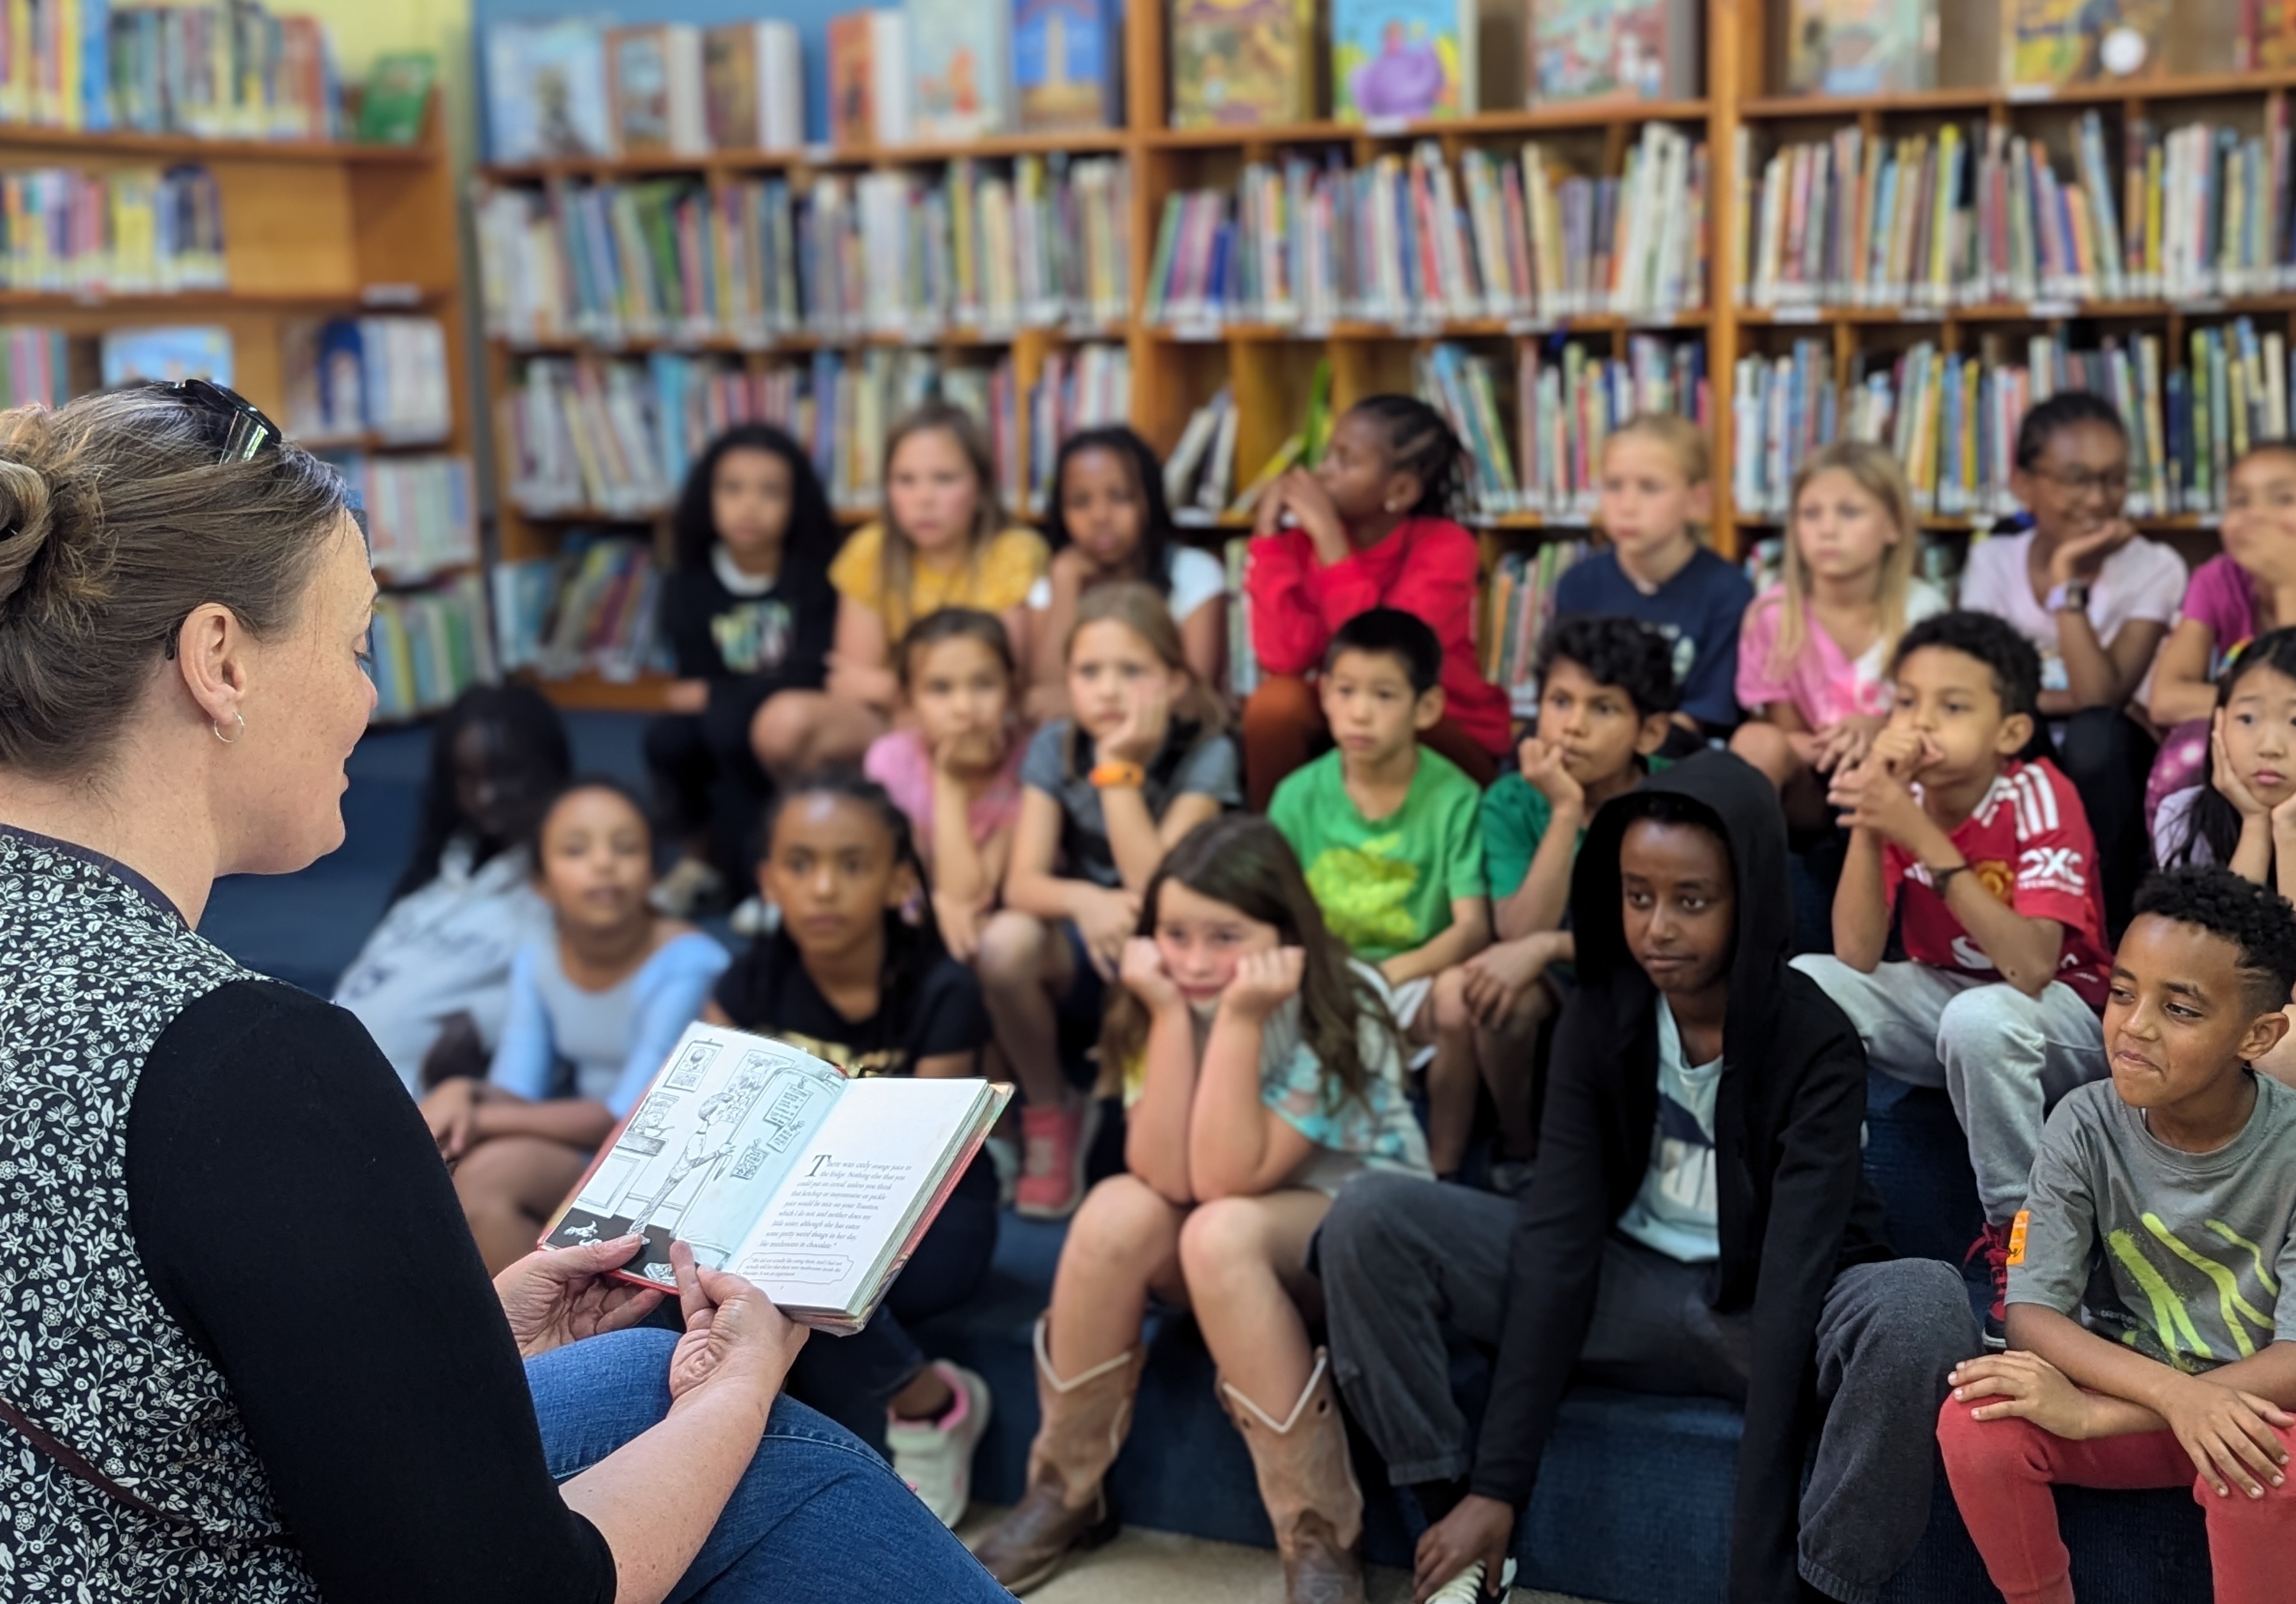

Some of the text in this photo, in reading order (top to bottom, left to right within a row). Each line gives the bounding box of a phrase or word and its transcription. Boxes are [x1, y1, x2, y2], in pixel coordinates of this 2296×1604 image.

[2018, 846, 2086, 886] DXC
[856, 1160, 872, 1171] only
[846, 1172, 870, 1180] Nothing
[802, 1190, 822, 1199] ketchup
[868, 1193, 887, 1201] pickle
[800, 1219, 824, 1229] although
[778, 1231, 796, 1239] pretty
[811, 1230, 829, 1240] things
